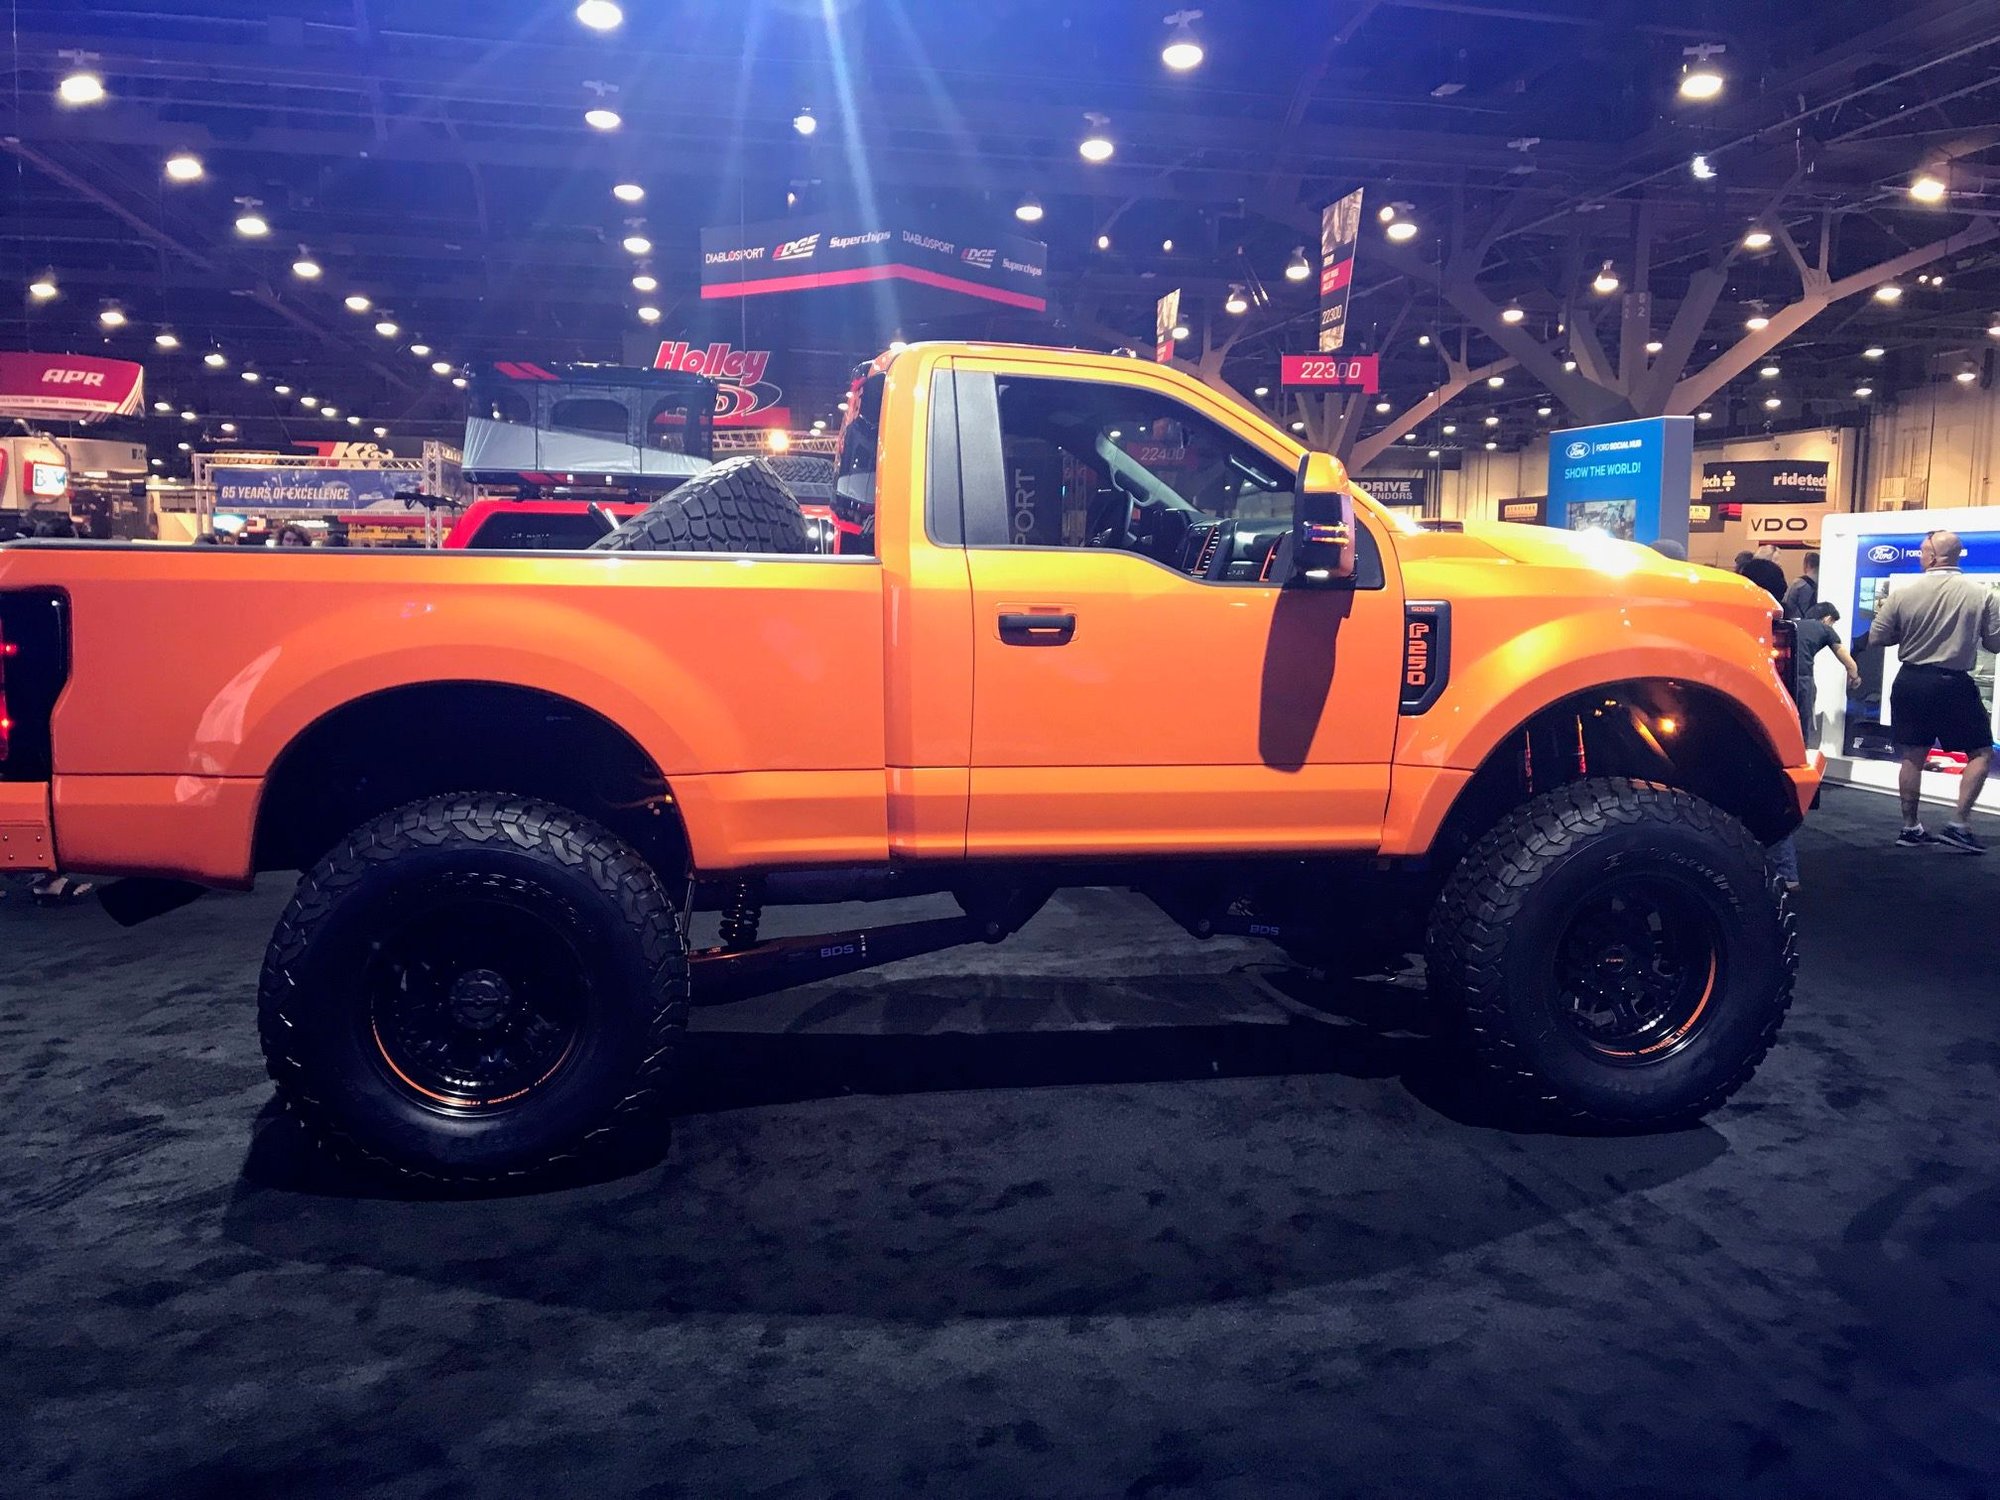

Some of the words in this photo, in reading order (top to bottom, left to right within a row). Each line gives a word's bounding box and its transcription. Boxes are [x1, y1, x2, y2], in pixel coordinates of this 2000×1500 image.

[705, 247, 765, 264] DIABLOSPORT
[772, 233, 821, 260] EDGE
[828, 231, 891, 249] Superchips
[902, 230, 955, 255] DIABLOSPORT
[1002, 257, 1043, 276] Superchips
[1321, 304, 1343, 325] 22300
[653, 340, 771, 387] Holley
[1300, 361, 1361, 379] 22300
[41, 369, 105, 387] APR
[1568, 443, 1588, 457] Ford
[1564, 466, 1589, 479] SHOW
[1590, 464, 1606, 477] THE
[1606, 462, 1641, 476] WORLD!
[221, 486, 236, 499] 65
[238, 486, 271, 499] YEARS
[273, 487, 288, 500] OF
[288, 487, 351, 501] EXCELLENCE
[1370, 492, 1413, 500] ENDORS
[1751, 517, 1808, 532] VDO
[1871, 546, 1896, 561] Ford
[1249, 923, 1281, 936] BDS
[820, 944, 855, 958] BDS
